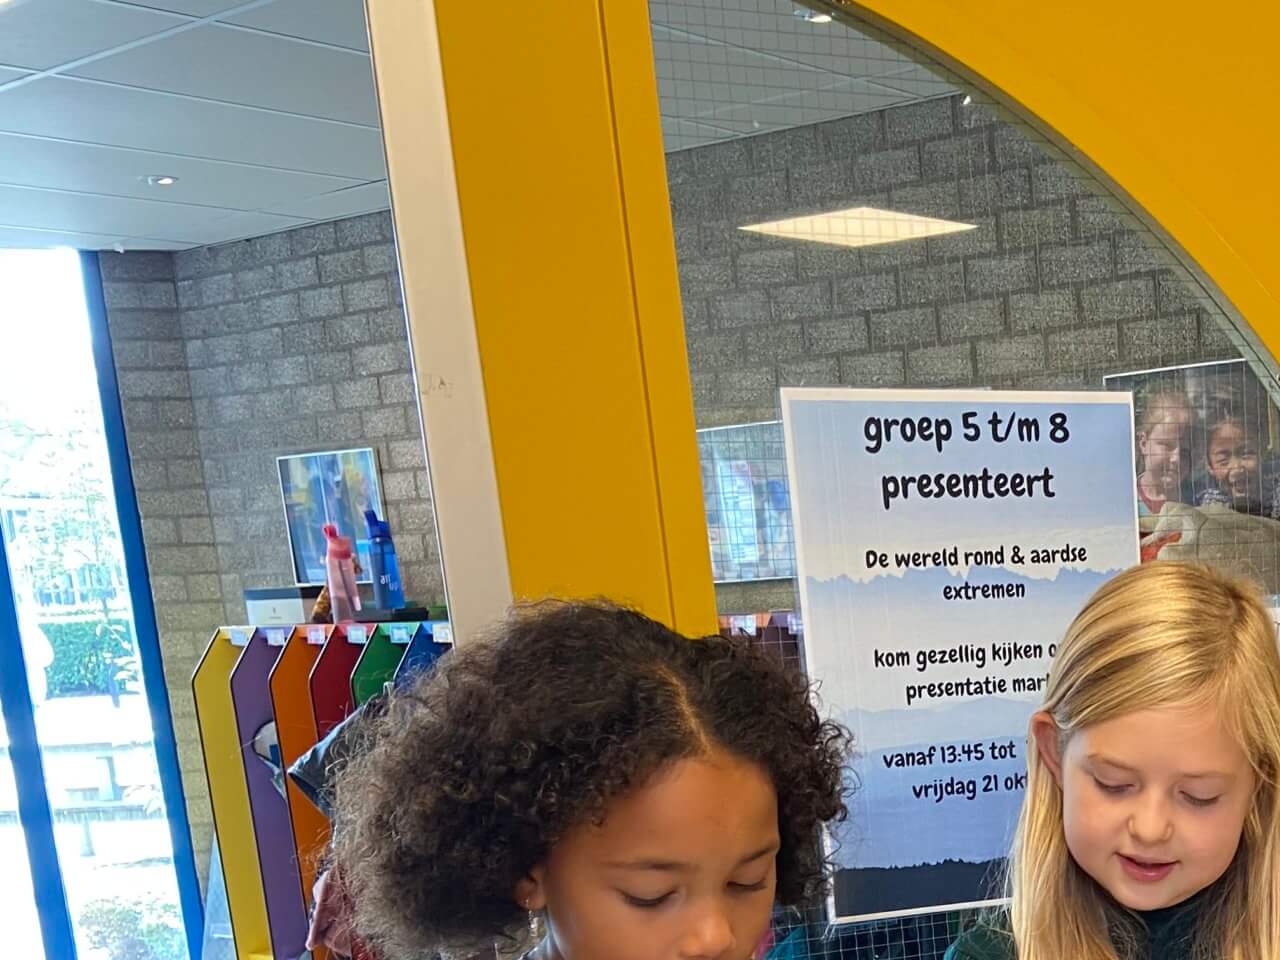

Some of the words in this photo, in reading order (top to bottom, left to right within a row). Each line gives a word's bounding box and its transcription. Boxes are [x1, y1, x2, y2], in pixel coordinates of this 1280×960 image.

[863, 413, 953, 455] groep
[962, 411, 980, 442] 5
[990, 411, 1040, 443] t/m
[1048, 411, 1070, 444] 8
[881, 466, 1056, 509] presenteert
[865, 549, 890, 570] De
[894, 546, 959, 570] wereld
[963, 543, 1005, 567] rond
[1010, 546, 1026, 566] &
[1030, 543, 1087, 564] aardse
[942, 580, 1026, 602] extremen
[873, 646, 911, 669] kom
[915, 642, 987, 672] gezellig
[991, 638, 1044, 666] kijken
[905, 676, 1008, 706] presentatie
[883, 745, 936, 770] vanaf
[940, 742, 985, 764] 13:45
[989, 740, 1017, 760] tot
[911, 776, 977, 801] vrijdag
[982, 774, 998, 793] 21
